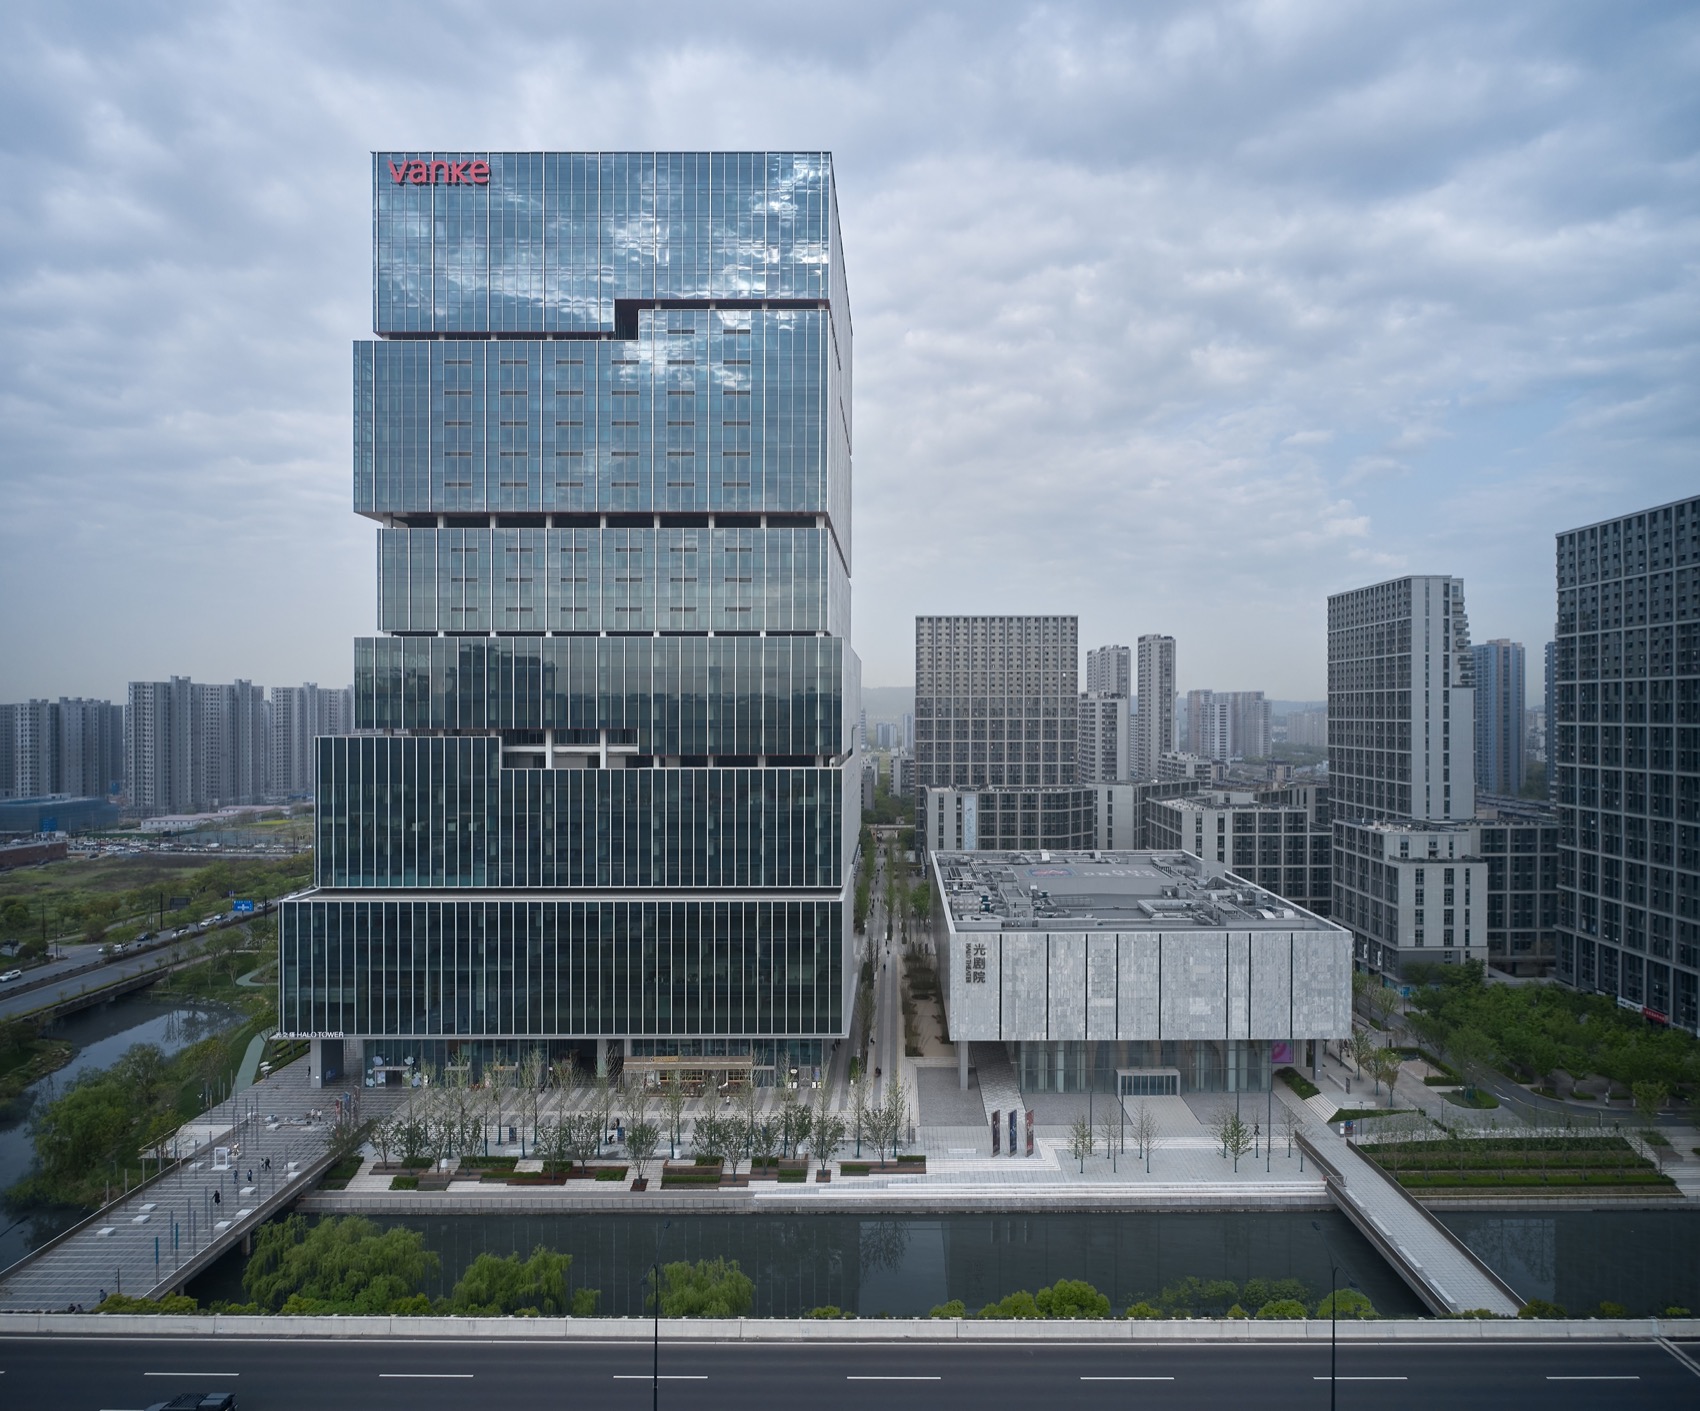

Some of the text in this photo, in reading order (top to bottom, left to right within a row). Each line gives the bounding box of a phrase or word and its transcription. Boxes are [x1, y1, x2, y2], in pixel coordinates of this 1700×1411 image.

[387, 159, 490, 184] vanke
[972, 943, 986, 984] 光剧院
